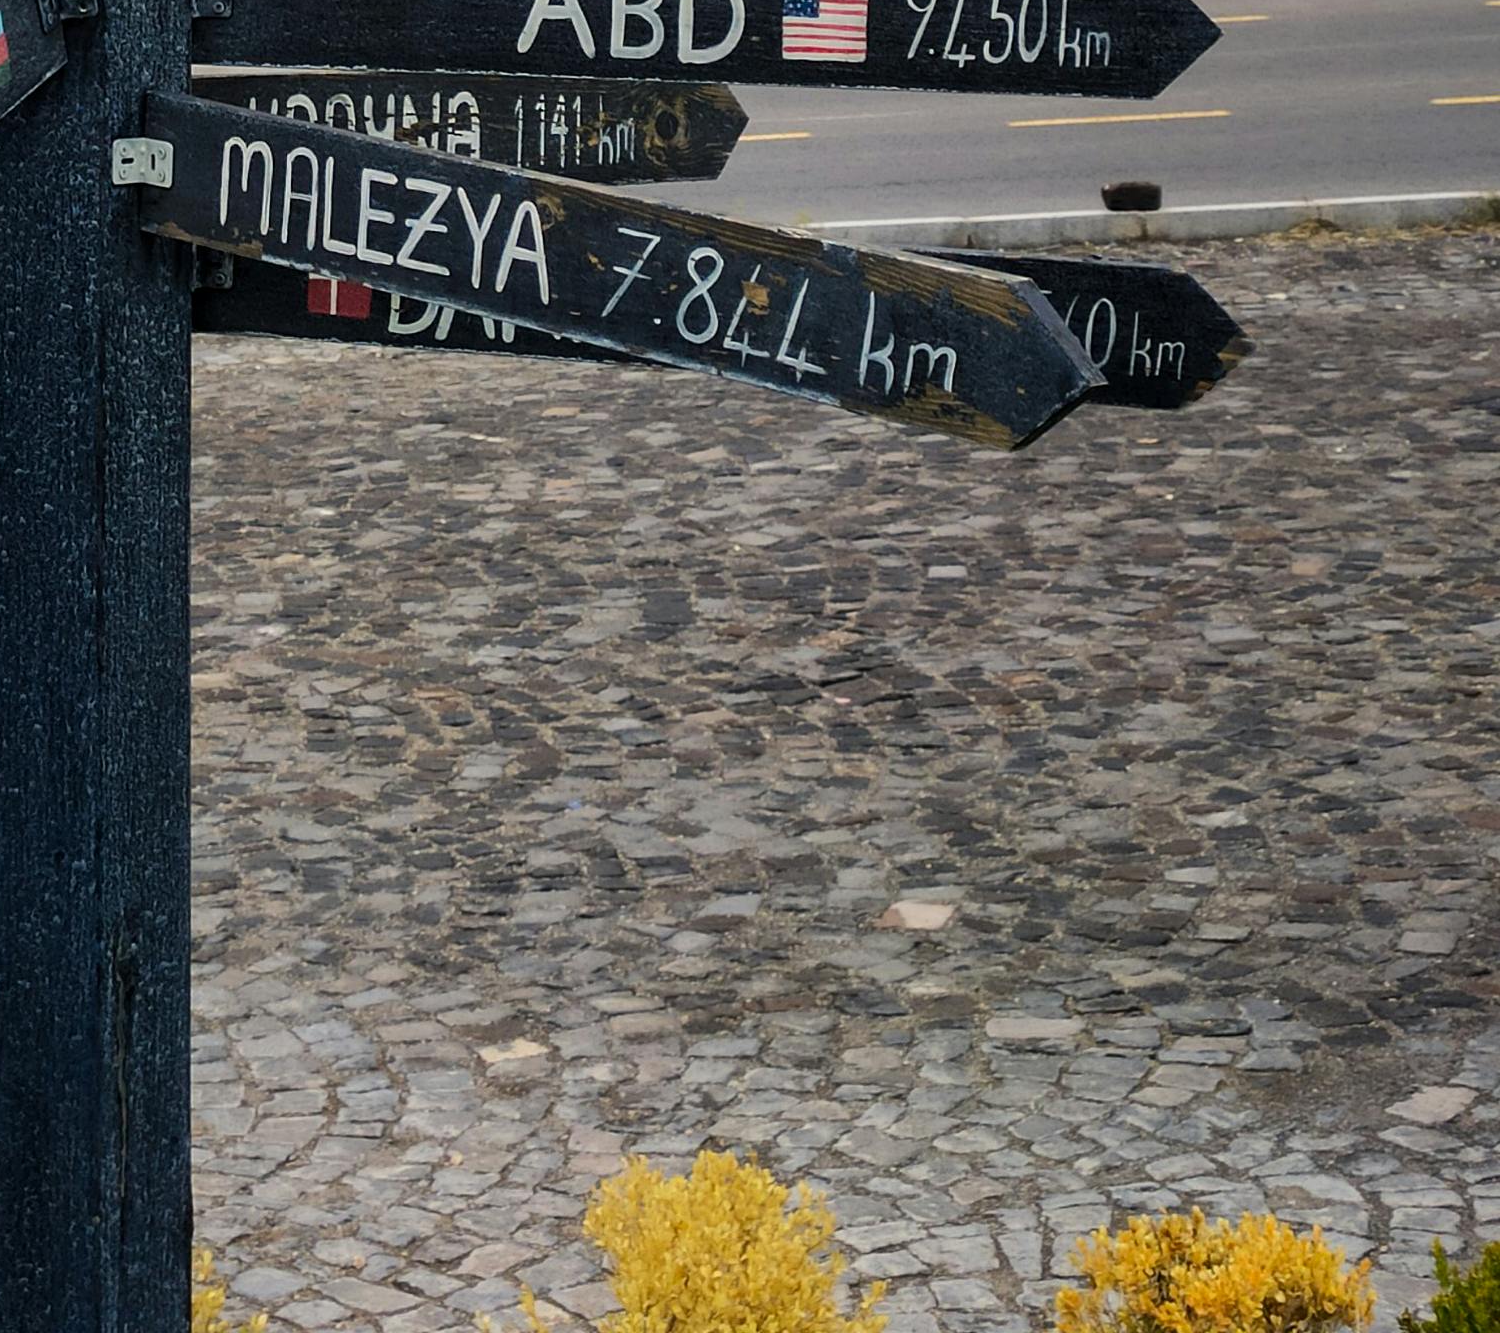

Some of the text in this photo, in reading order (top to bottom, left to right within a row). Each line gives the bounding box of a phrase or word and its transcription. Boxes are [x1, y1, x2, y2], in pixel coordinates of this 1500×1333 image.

[1060, 0, 1111, 68] km
[598, 95, 636, 165] km
[220, 135, 550, 306] MALEZYA
[601, 227, 826, 381] 7.844
[859, 290, 958, 395] km
[1129, 311, 1186, 380] km
